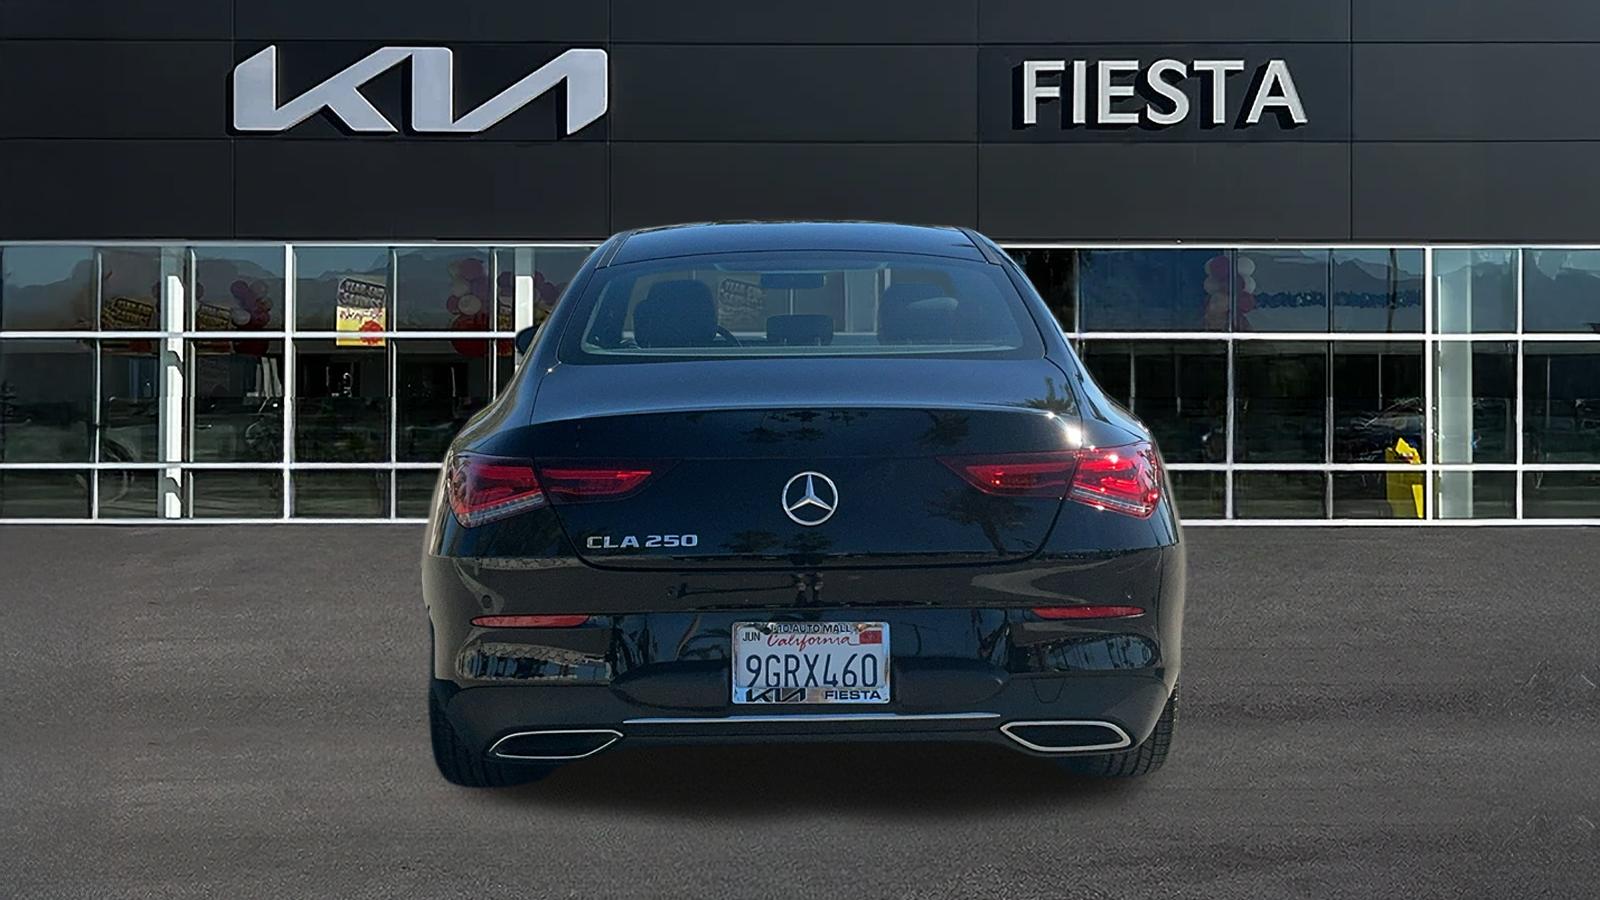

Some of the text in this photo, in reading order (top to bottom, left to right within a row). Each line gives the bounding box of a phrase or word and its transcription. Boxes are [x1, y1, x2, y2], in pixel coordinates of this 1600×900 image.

[233, 45, 608, 135] KIA
[1023, 59, 1308, 125] FIESTA
[586, 534, 698, 549] CLA 250
[792, 623, 820, 633] AUTO
[822, 623, 852, 633] MALL
[742, 631, 760, 641] JUN
[767, 633, 859, 652] California
[745, 653, 878, 688] 9GRX460
[746, 687, 806, 702] KIA
[824, 690, 882, 700] FIESTA
